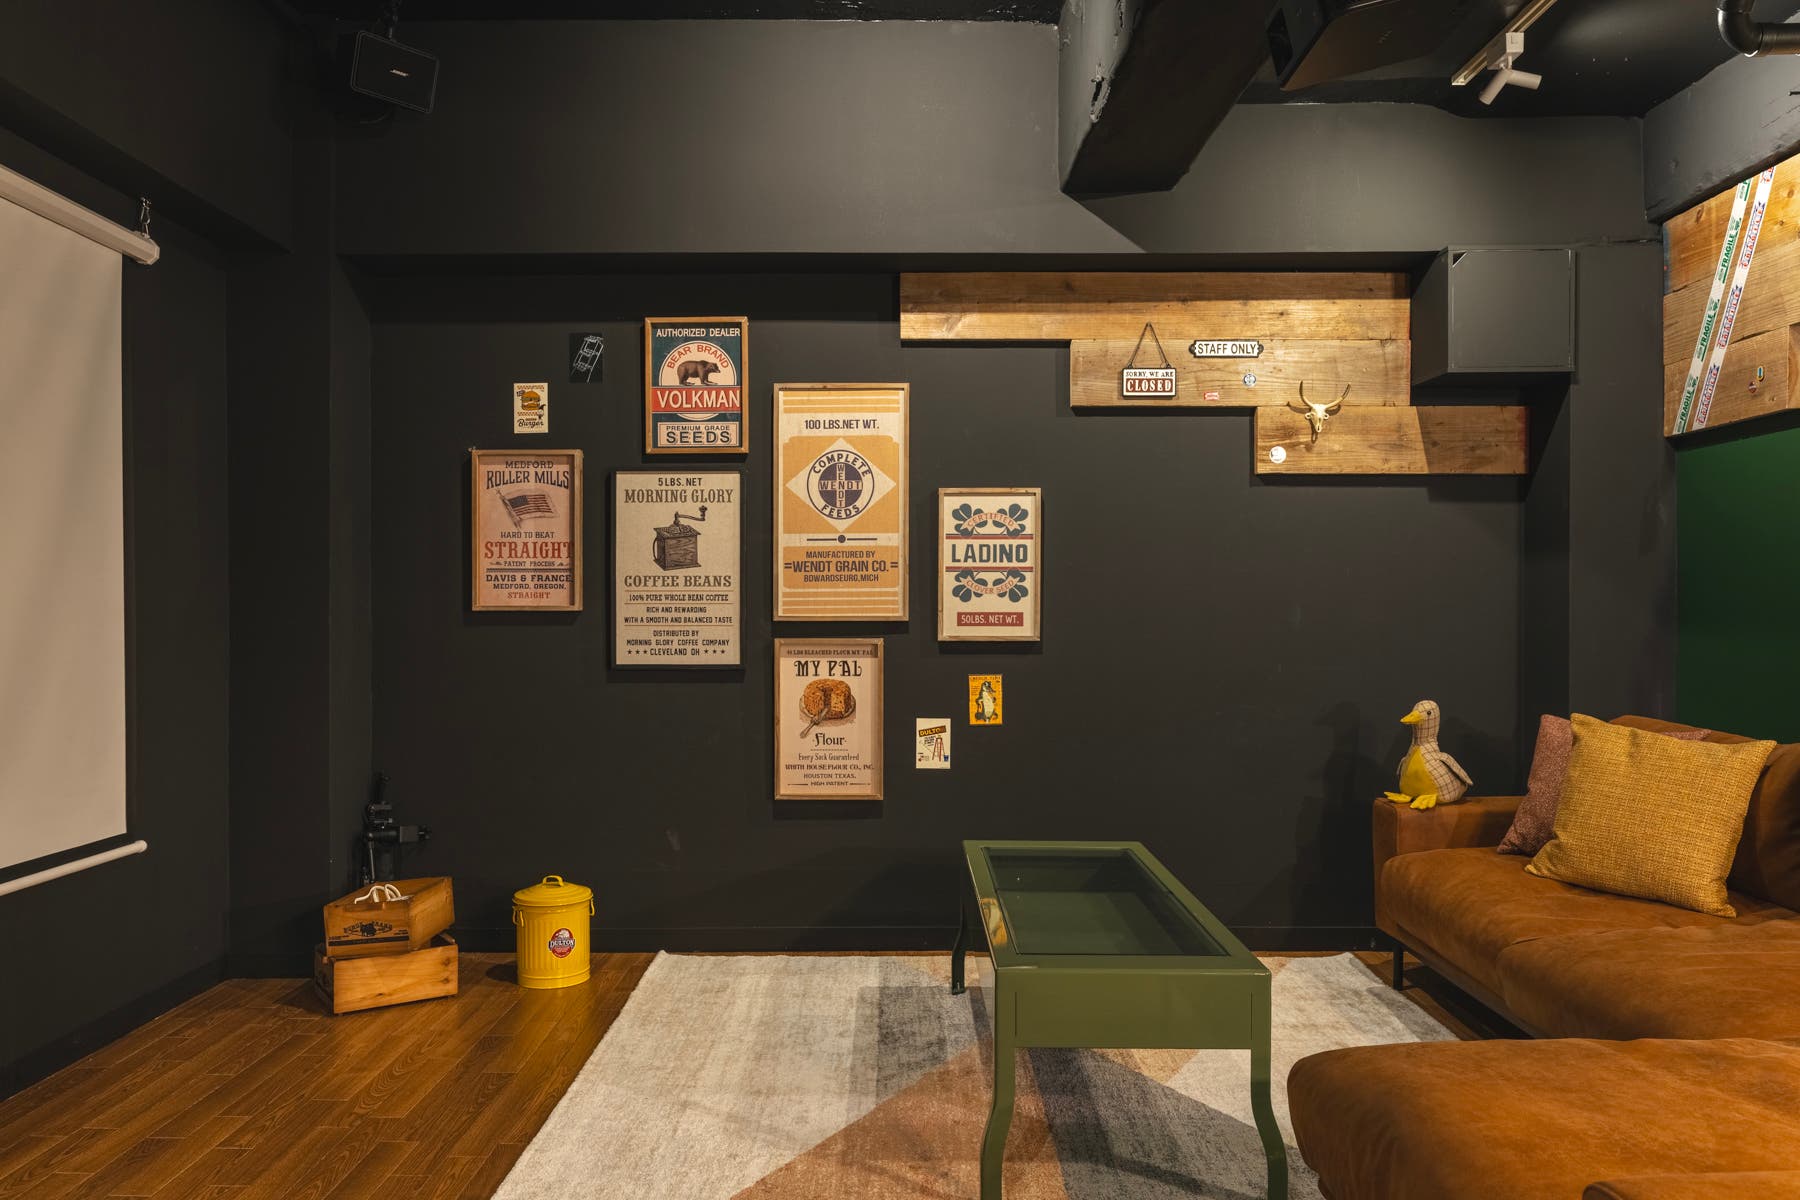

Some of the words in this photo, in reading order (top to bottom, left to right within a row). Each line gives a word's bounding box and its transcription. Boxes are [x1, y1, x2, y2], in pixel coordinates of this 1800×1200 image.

[1721, 234, 1736, 268] FRAGILE
[656, 328, 706, 337] AUTHORIZED
[709, 328, 741, 337] DEALER
[1700, 313, 1714, 346] FRAGILE
[1197, 343, 1228, 354] STAFF
[1230, 343, 1257, 354] ONLY
[667, 346, 692, 369] BEAR
[696, 344, 729, 369] BRAND
[1126, 379, 1172, 392] CLOSED
[656, 390, 740, 409] VOLKMAN
[1679, 390, 1693, 421] FRAGILE
[805, 419, 821, 430] 100
[862, 419, 880, 430] WT.
[666, 431, 732, 444] SEEDS
[505, 461, 554, 469] MEDFORD
[813, 453, 871, 477] COMPLETE
[486, 470, 530, 490] ROLLER
[534, 470, 570, 490] MILLS
[685, 477, 703, 487] NET
[820, 481, 861, 490] WENDT
[624, 488, 687, 504] MORNING
[691, 488, 734, 504] GLORY
[821, 504, 861, 518] FEEDS
[500, 531, 522, 539] HARD
[524, 531, 533, 539] TO
[535, 531, 555, 539] BEAT
[484, 541, 575, 559] STRAIGHT
[805, 551, 864, 559] MANUFACTURED
[865, 550, 876, 558] BY
[951, 543, 1028, 563] LADINO
[793, 560, 832, 572] WENDT
[835, 560, 869, 572] GRAIN
[871, 560, 889, 572] CO.
[486, 574, 517, 583] DAVIS
[520, 574, 527, 582] &
[624, 575, 680, 588] COFFEE
[683, 575, 732, 588] BEANS
[966, 580, 995, 595] CLOVER
[996, 580, 1014, 592] SEED
[507, 592, 551, 600] STRAIGHT
[629, 594, 645, 602] 100%
[646, 594, 663, 602] PURE
[664, 594, 687, 602] WHOLE
[688, 594, 704, 602] BEAN
[705, 594, 729, 602] COFFEE
[646, 616, 669, 624] SMOOTH
[988, 614, 1003, 623] NET
[1005, 614, 1020, 623] WT.
[650, 648, 688, 656] CLEVELAND
[690, 648, 700, 656] OH
[794, 660, 820, 677] MY
[827, 660, 862, 677] PAL
[815, 733, 845, 747] Flour
[798, 753, 814, 763] Every
